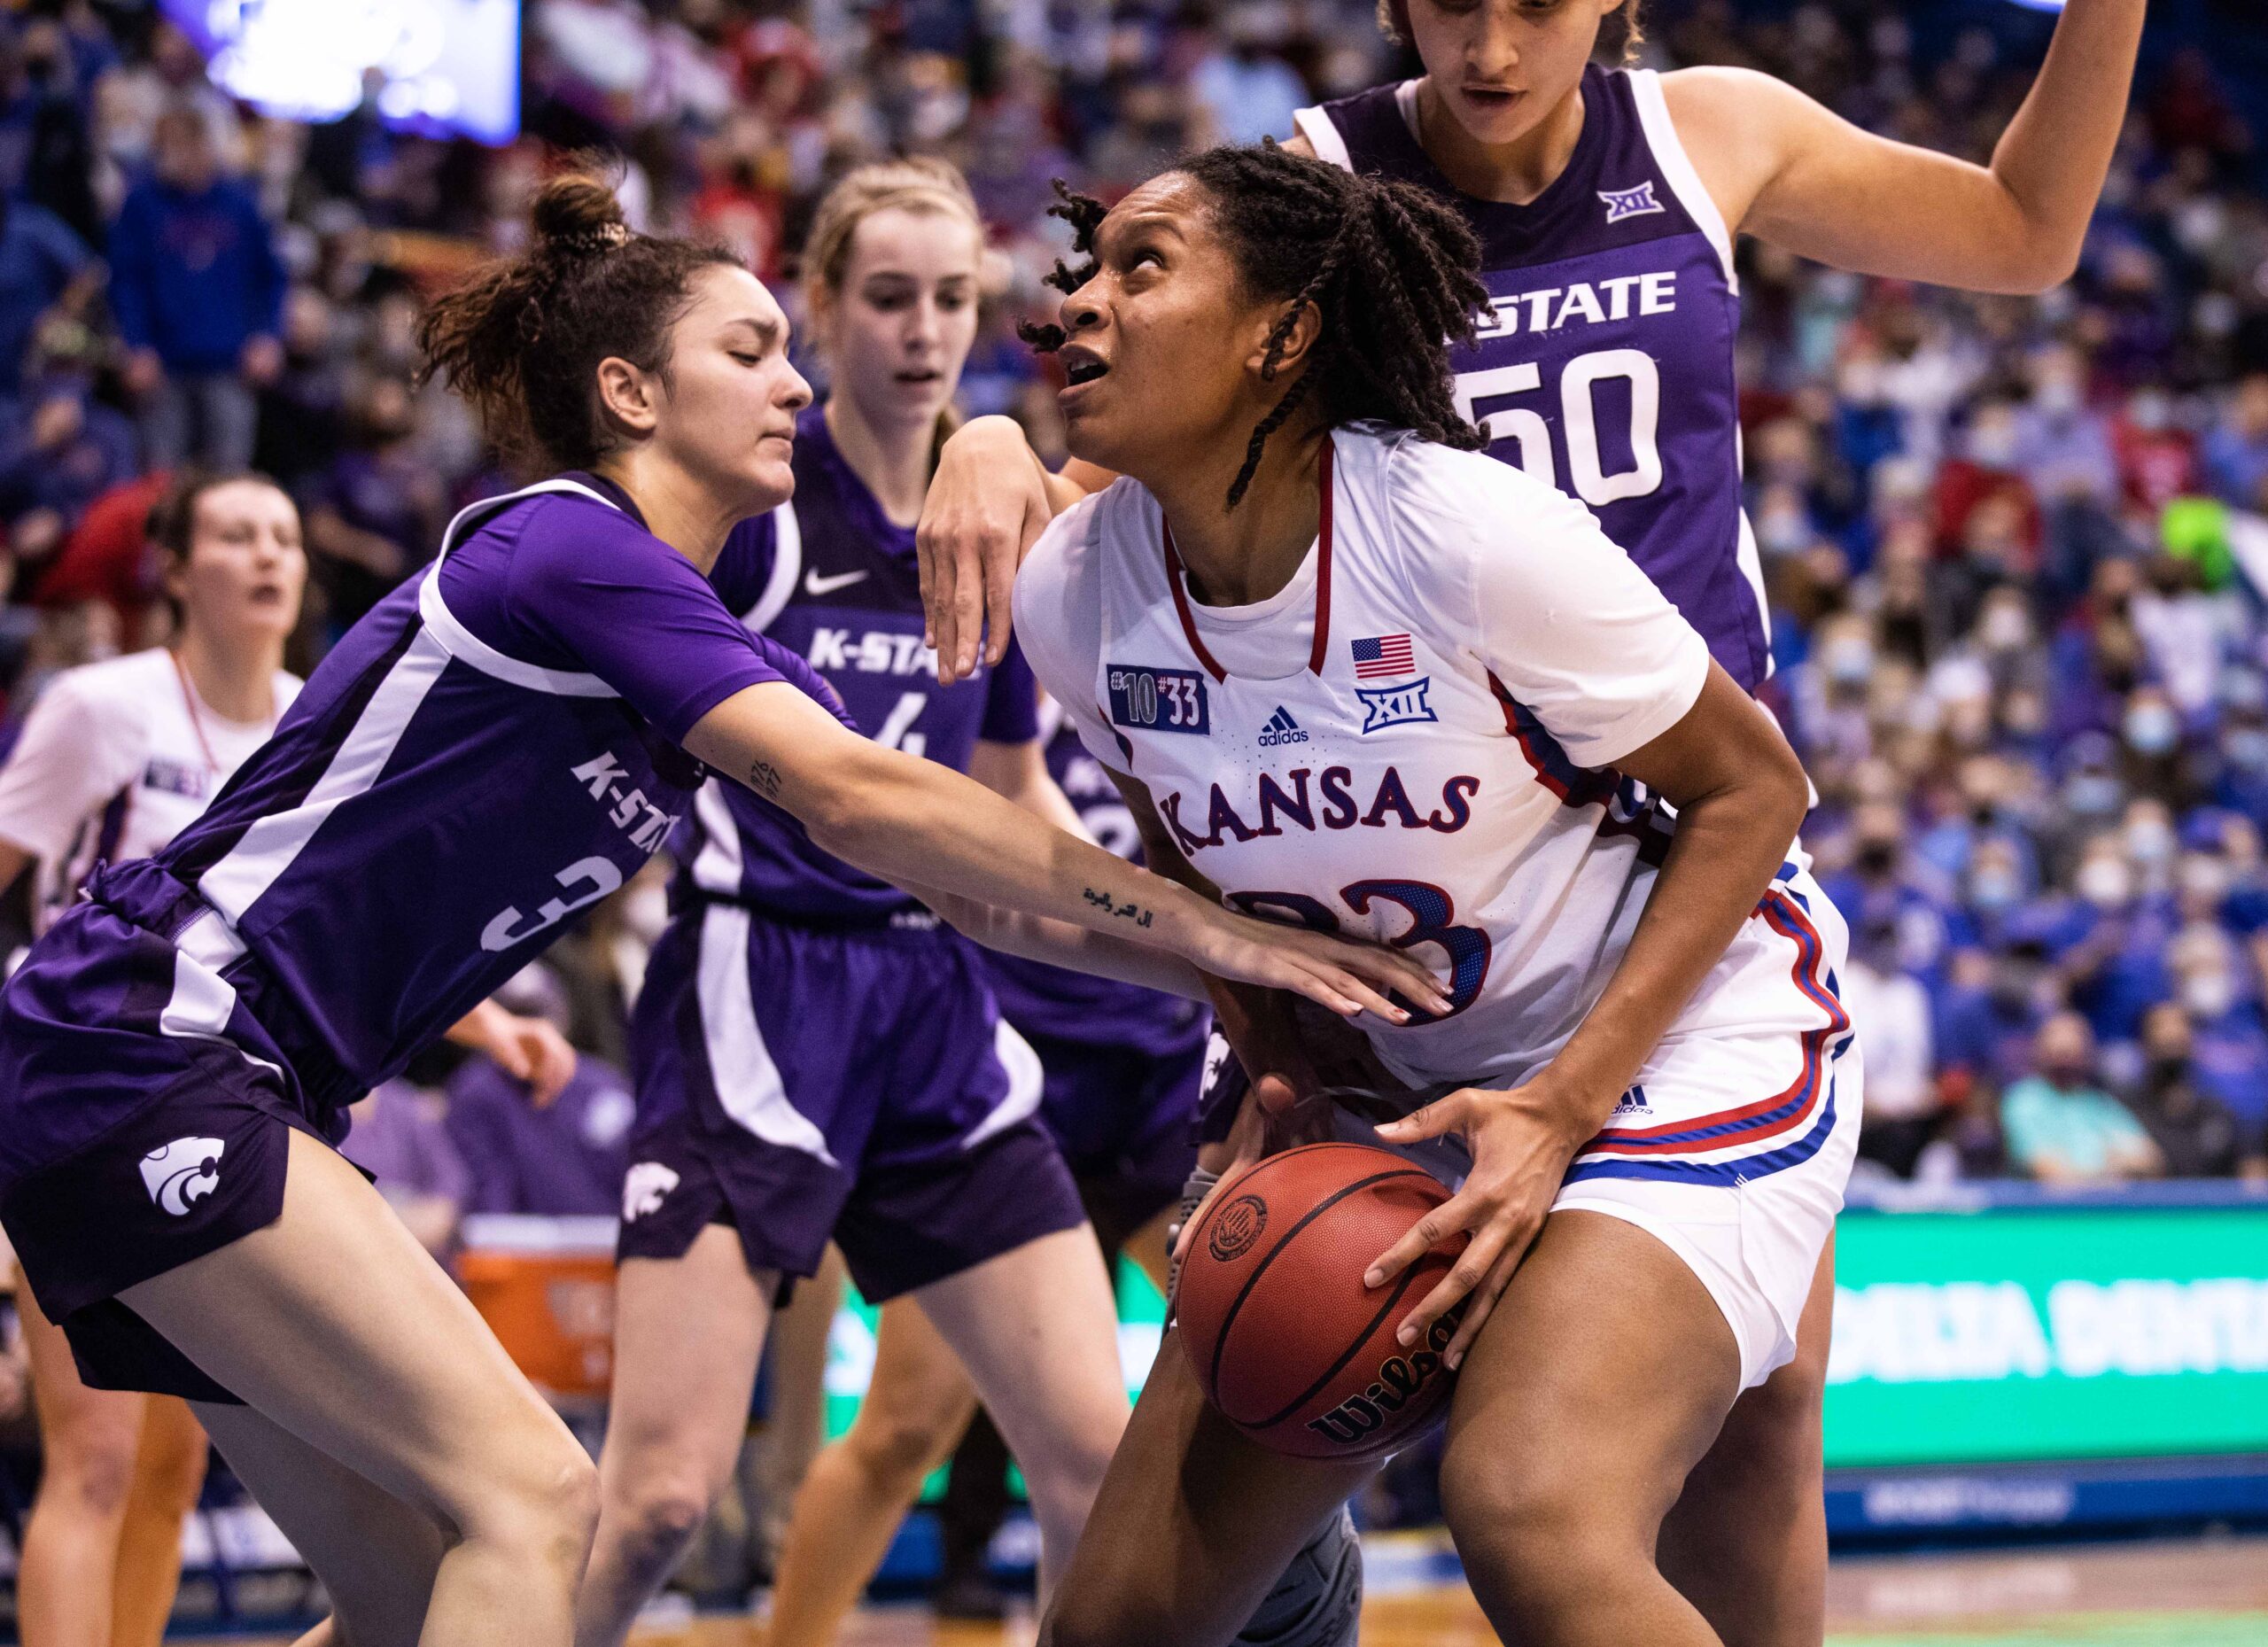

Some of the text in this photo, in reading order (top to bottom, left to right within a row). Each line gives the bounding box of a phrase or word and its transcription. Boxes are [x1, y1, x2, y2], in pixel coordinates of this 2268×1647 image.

[1442, 271, 1677, 346] STATE
[1454, 348, 1663, 507] 50
[809, 627, 983, 680] K-STA
[874, 692, 927, 757] 4
[1110, 672, 1200, 726] #10 #33
[1258, 728, 1309, 747] adidas
[570, 750, 682, 853] K-STA
[1160, 765, 1480, 857] KANSAS
[480, 856, 622, 952] 3
[1612, 1104, 1654, 1115] didas
[1305, 1289, 1472, 1445] Wilso
